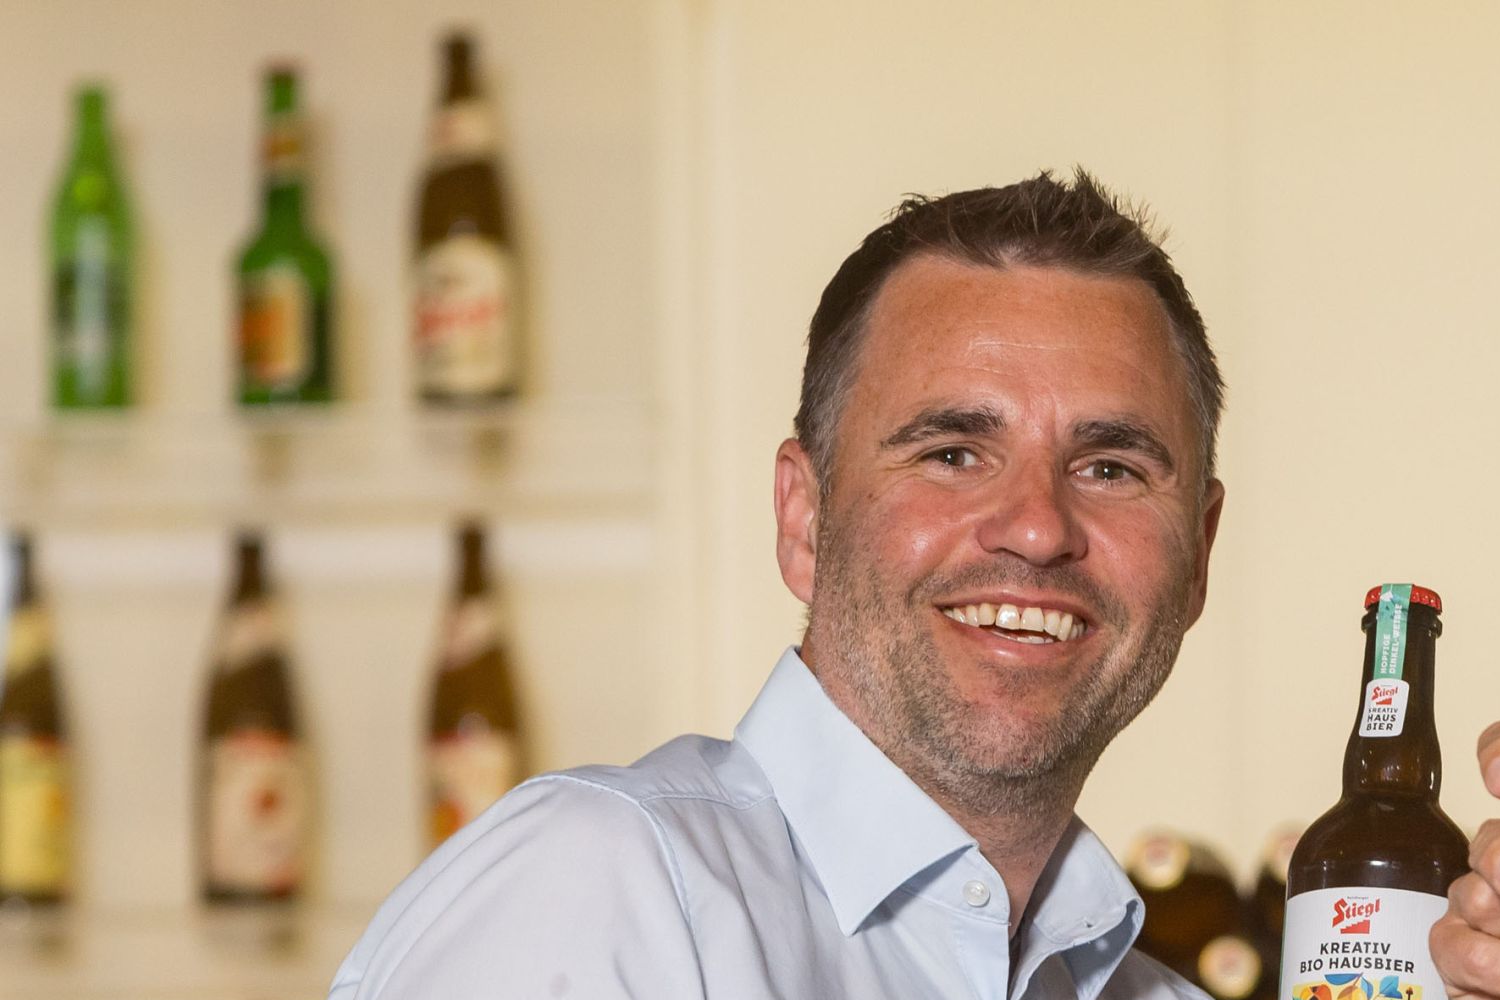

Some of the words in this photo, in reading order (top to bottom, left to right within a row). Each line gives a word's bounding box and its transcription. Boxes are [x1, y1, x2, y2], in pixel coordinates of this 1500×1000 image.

[1380, 633, 1391, 674] HOPFIGE
[1371, 685, 1399, 700] Stiegl
[1367, 714, 1397, 722] HAUS
[1366, 723, 1394, 731] BIER
[1332, 898, 1380, 928] Stiegl
[1319, 942, 1391, 956] KREATIV
[1300, 957, 1324, 974] BIO
[1328, 956, 1415, 974] HAUSBIER
